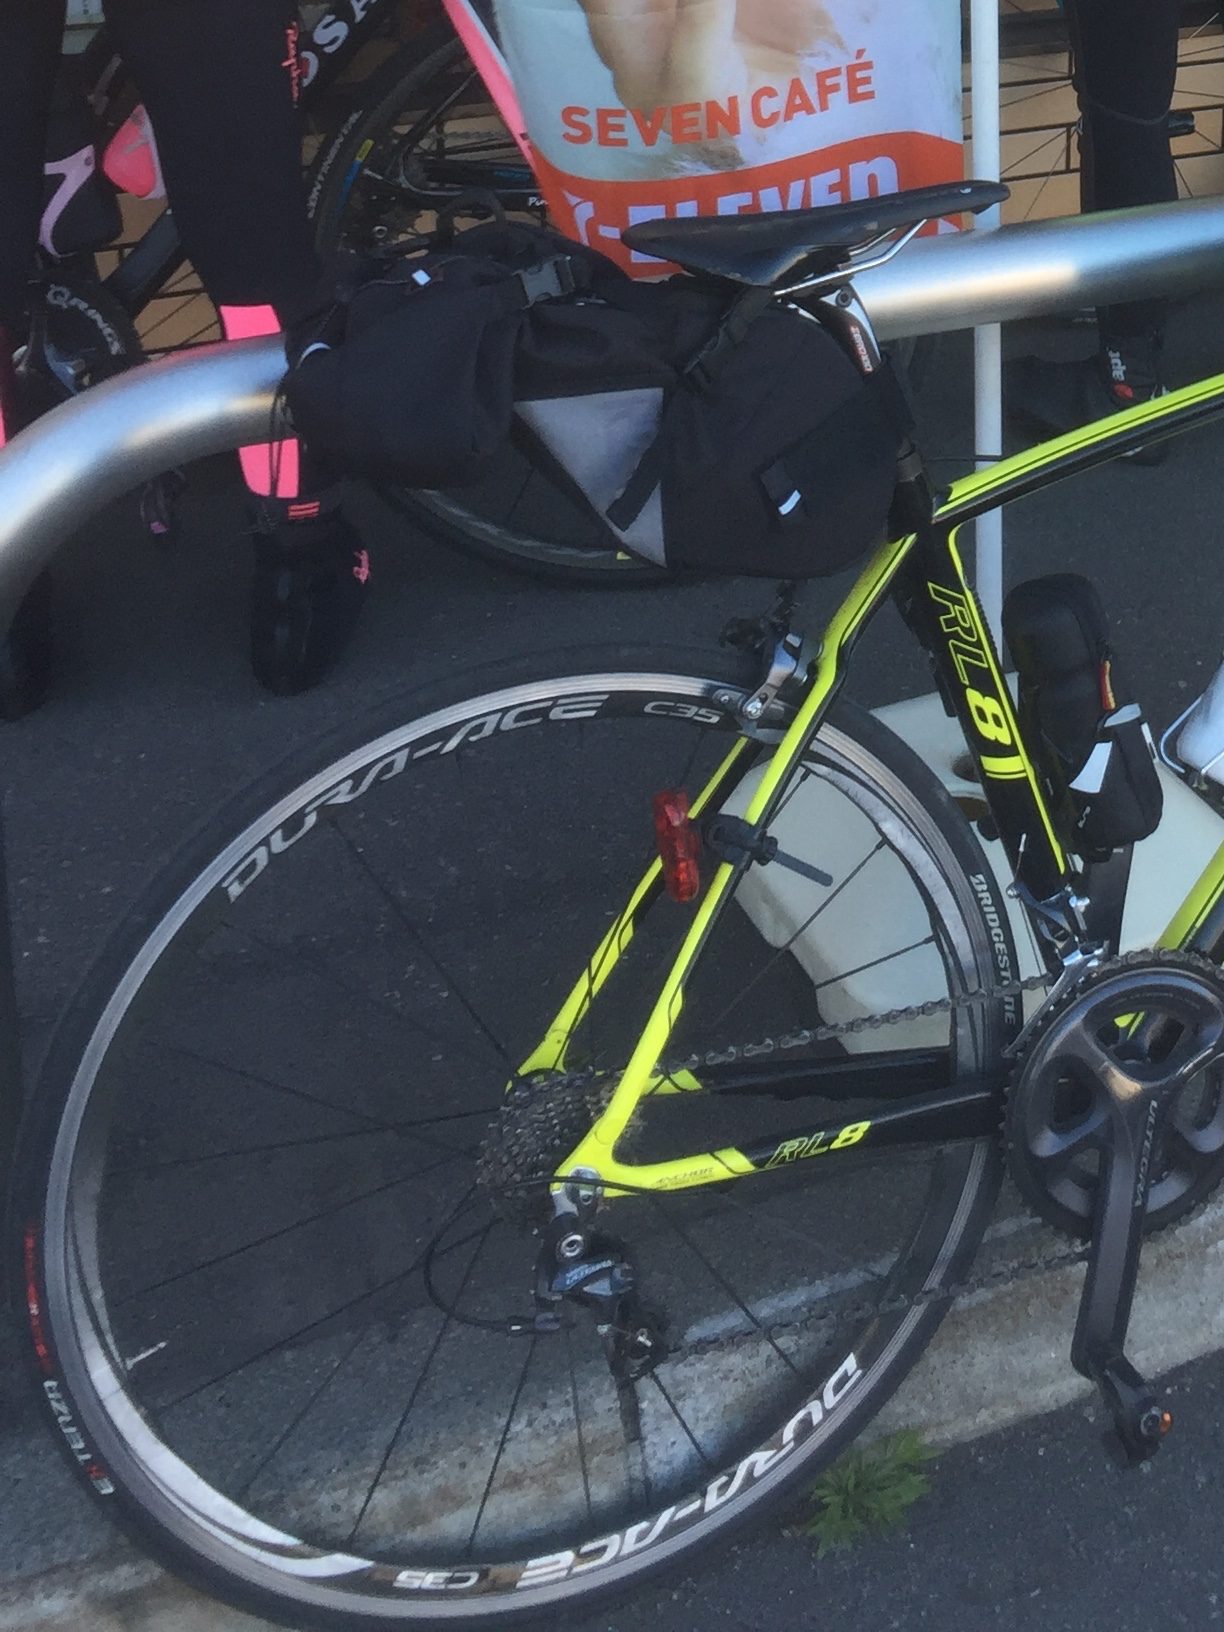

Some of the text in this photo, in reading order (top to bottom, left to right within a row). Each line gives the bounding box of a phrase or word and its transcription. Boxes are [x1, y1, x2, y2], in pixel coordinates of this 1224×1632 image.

[561, 49, 875, 147] SEVEN CAFÉ
[222, 694, 725, 905] DURA-ACE C35
[515, 1351, 862, 1590] DURA-ACE
